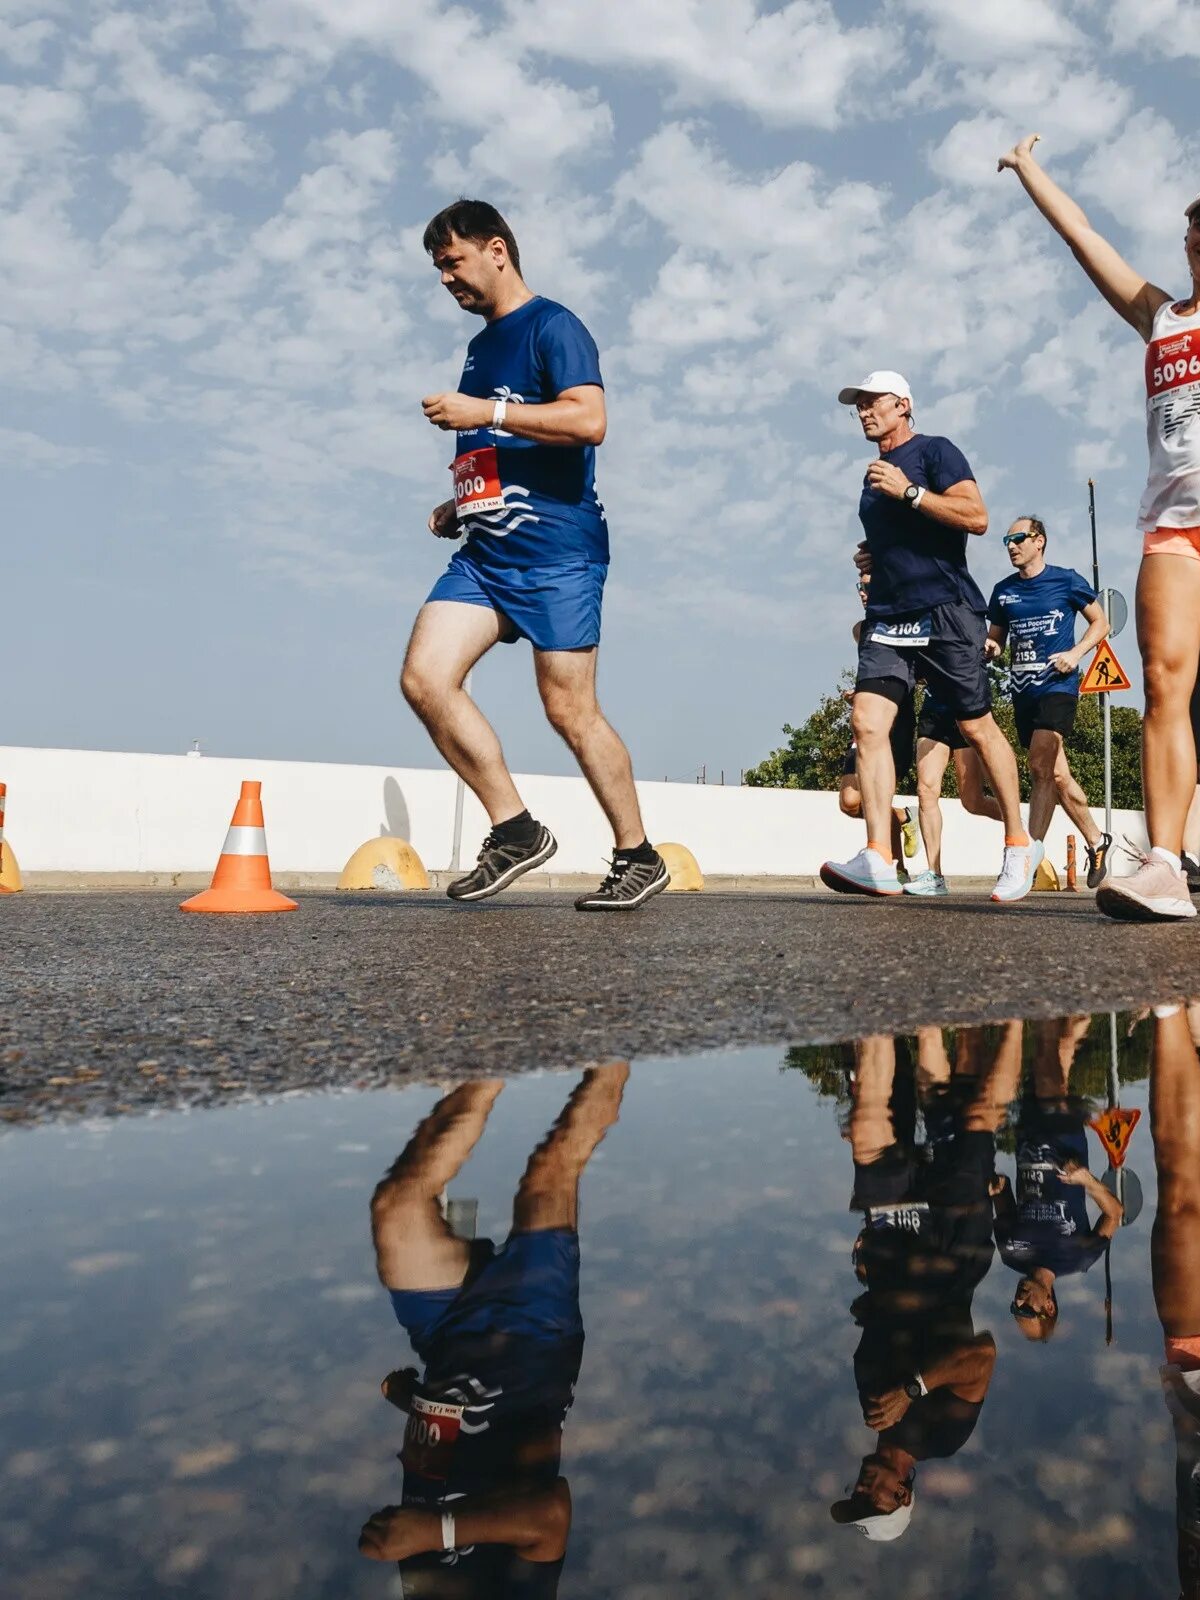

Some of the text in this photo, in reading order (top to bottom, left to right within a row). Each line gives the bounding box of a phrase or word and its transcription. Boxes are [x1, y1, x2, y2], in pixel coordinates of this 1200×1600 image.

[454, 475, 486, 501] 000
[887, 621, 921, 635] 2106
[1015, 651, 1037, 662] 2153
